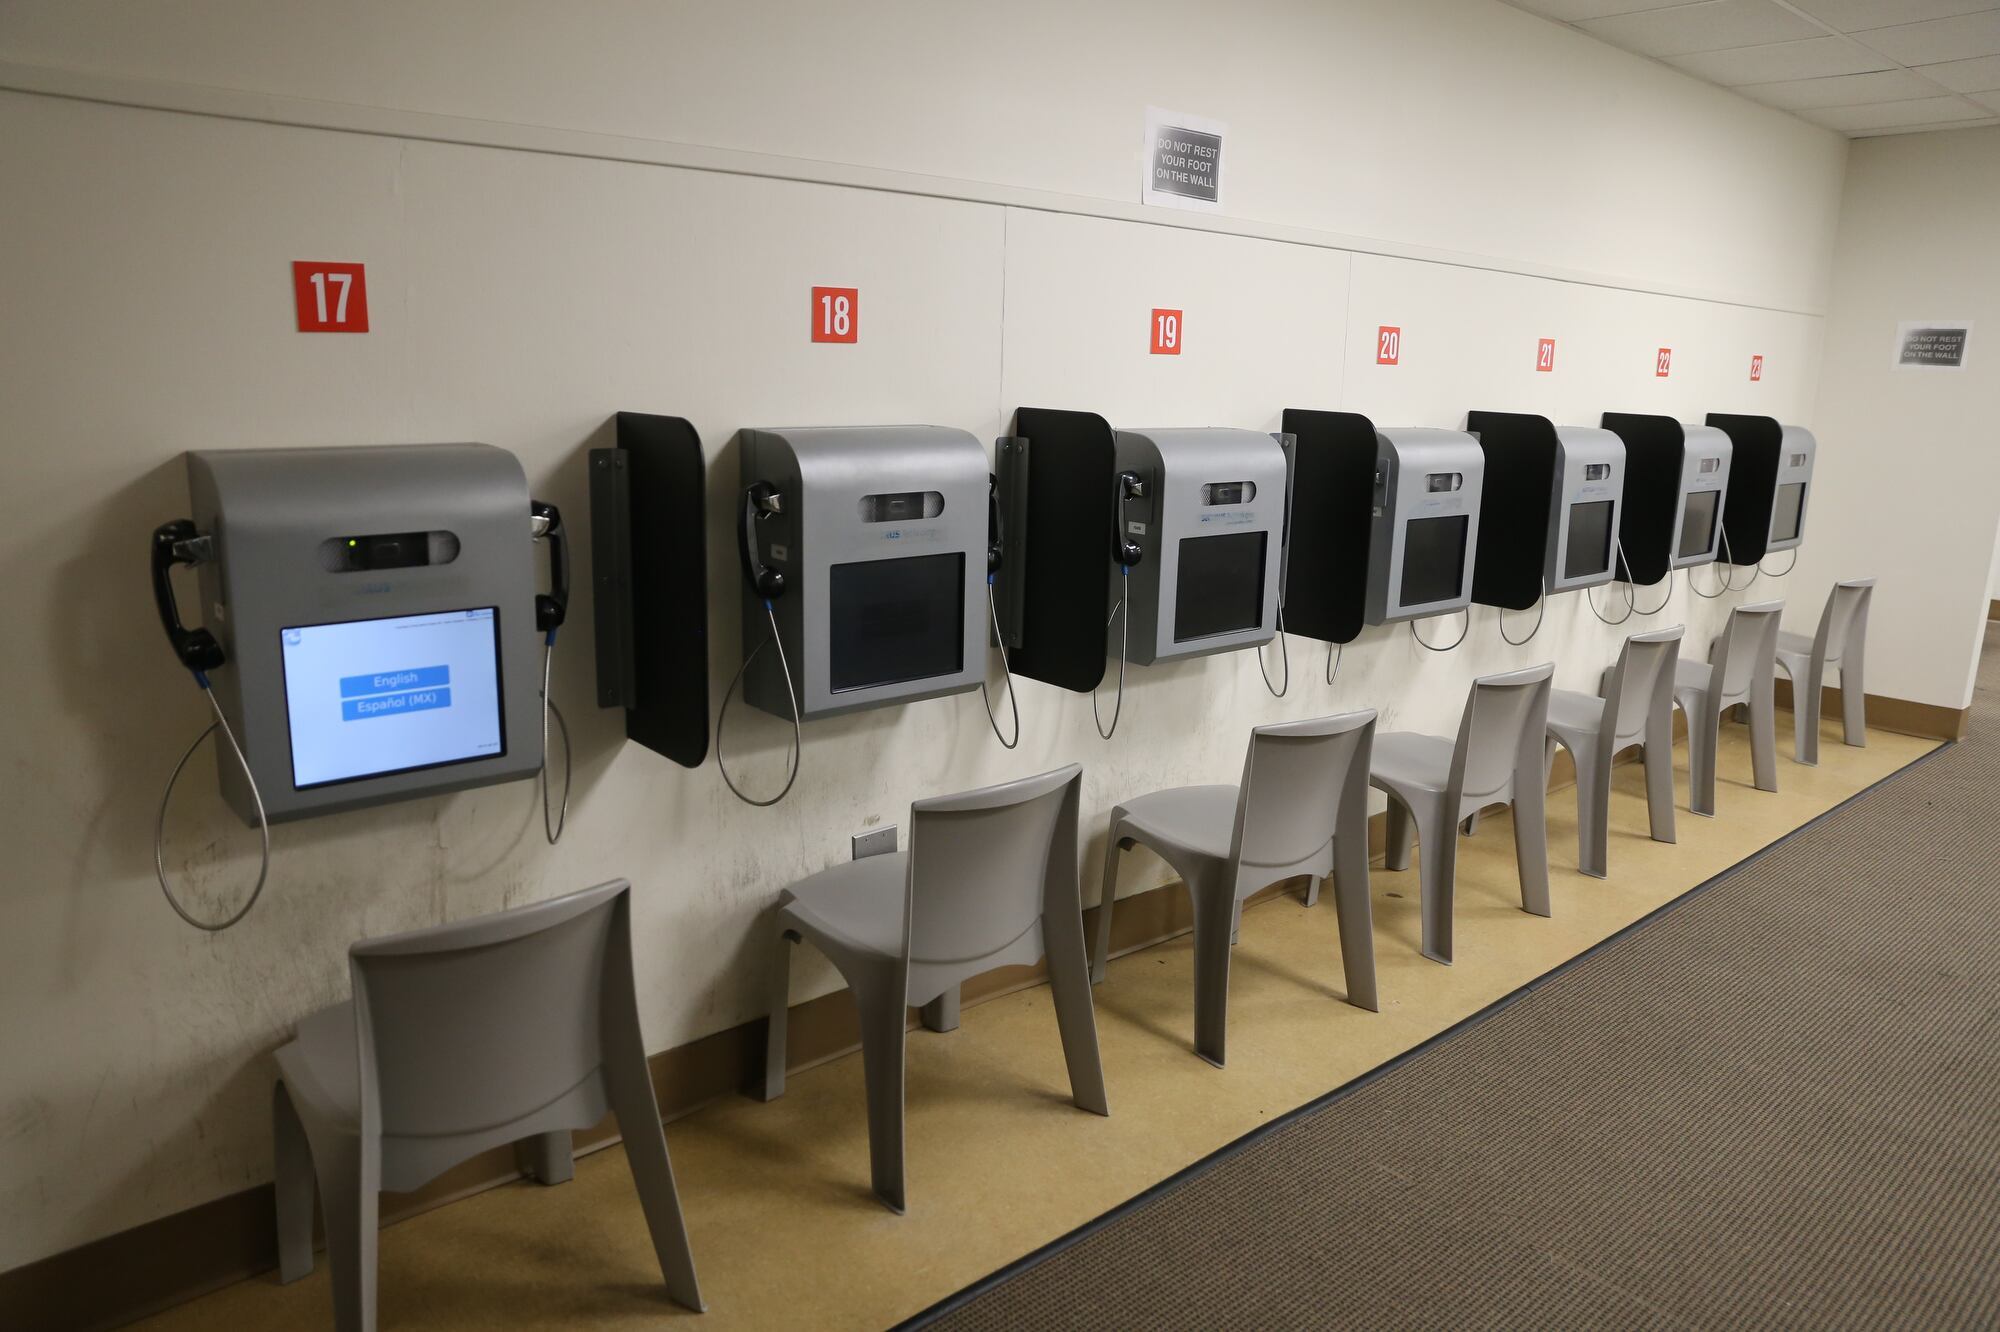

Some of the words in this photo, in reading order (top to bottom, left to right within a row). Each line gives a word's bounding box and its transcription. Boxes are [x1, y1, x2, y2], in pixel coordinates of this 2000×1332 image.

[1158, 138, 1172, 150] DO
[1173, 141, 1192, 154] NOT
[1194, 145, 1217, 159] REST
[1161, 154, 1186, 168] YOUR
[1187, 159, 1212, 173] FOOT
[1156, 168, 1170, 180] ON
[1170, 170, 1189, 183] THE
[1190, 173, 1214, 188] WALL
[310, 272, 353, 323] 17
[821, 295, 850, 336] 18
[1157, 315, 1177, 348] 19
[1380, 331, 1398, 359] 20
[1540, 343, 1552, 367] 21
[1933, 343, 1957, 351] FOOT
[1658, 352, 1670, 373] 22
[1751, 358, 1761, 378] 23
[373, 672, 418, 688] English
[357, 695, 406, 713] Español
[409, 691, 437, 707] (MX)
